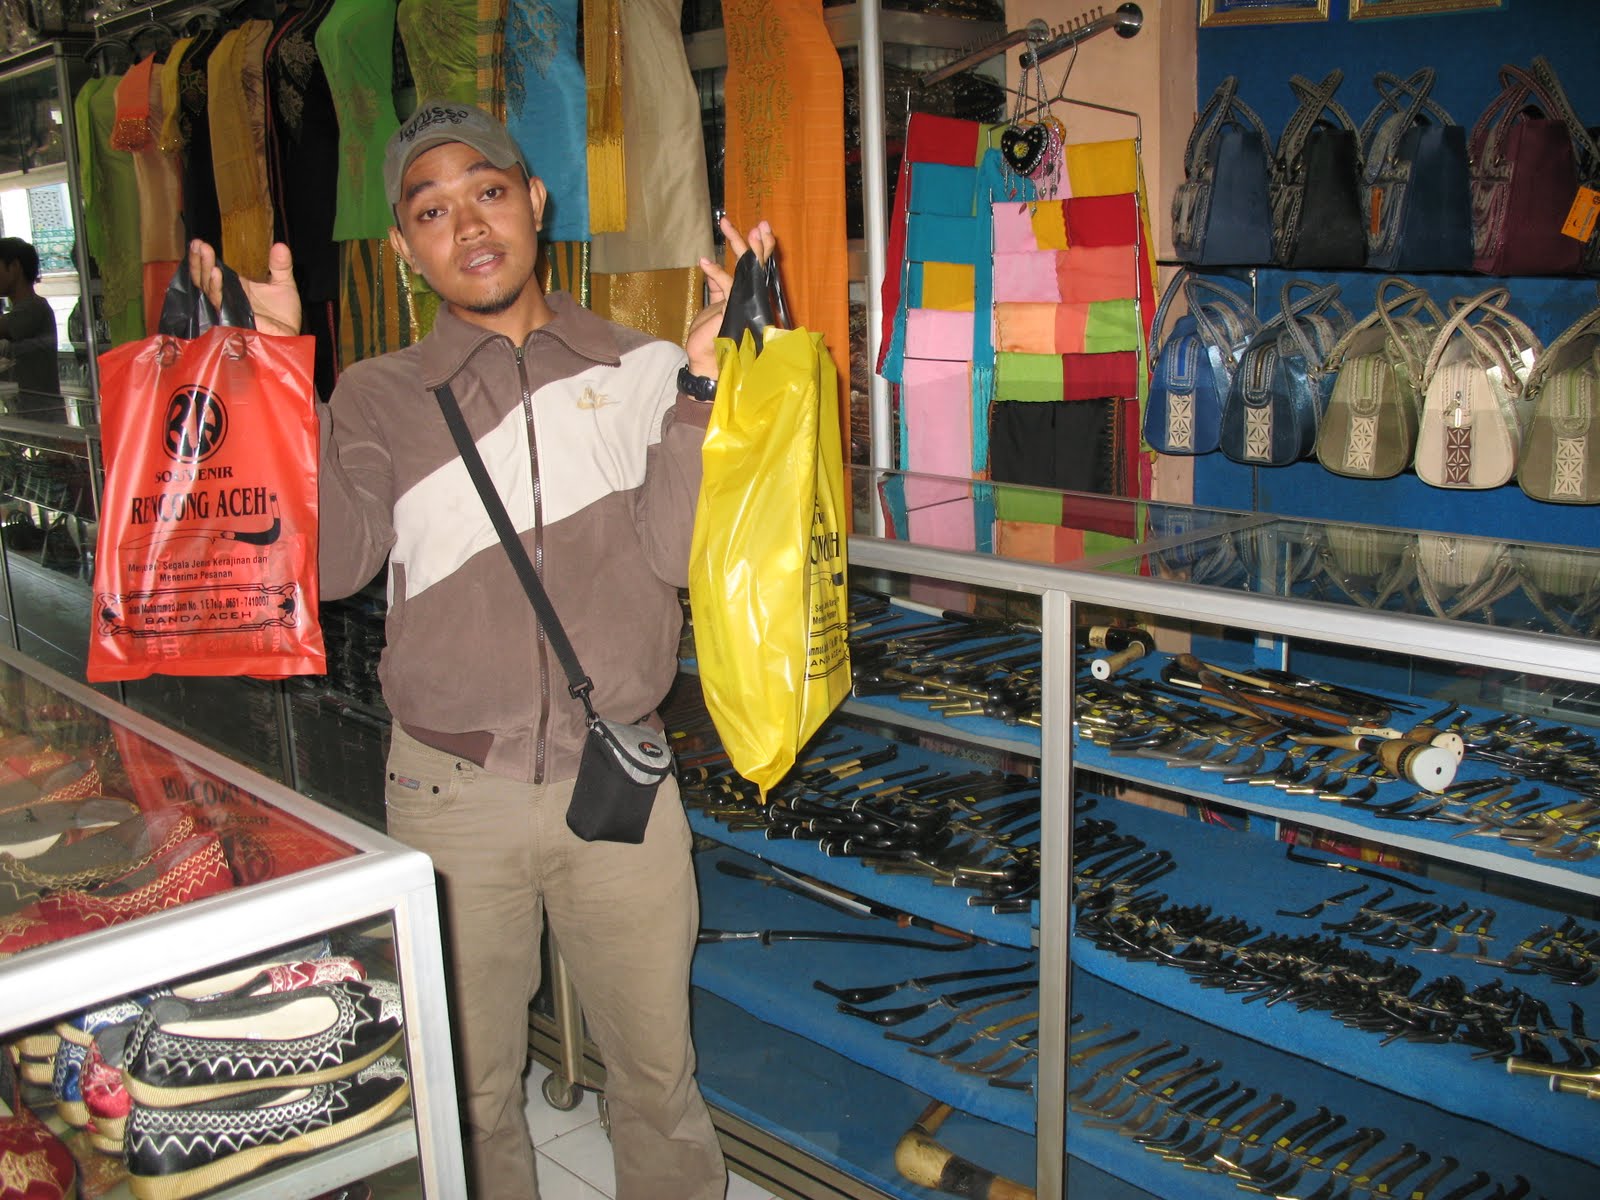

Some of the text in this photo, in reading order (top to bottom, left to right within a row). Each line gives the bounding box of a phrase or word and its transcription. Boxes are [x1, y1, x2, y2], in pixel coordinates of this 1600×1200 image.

[216, 487, 268, 518] ACEH
[163, 560, 190, 571] Segala
[191, 559, 211, 569] Jenis
[212, 557, 251, 568] Kerajinan
[253, 555, 268, 565] dan
[159, 570, 233, 582] Menerima Pesanan
[145, 611, 252, 624] BANDA ACEH
